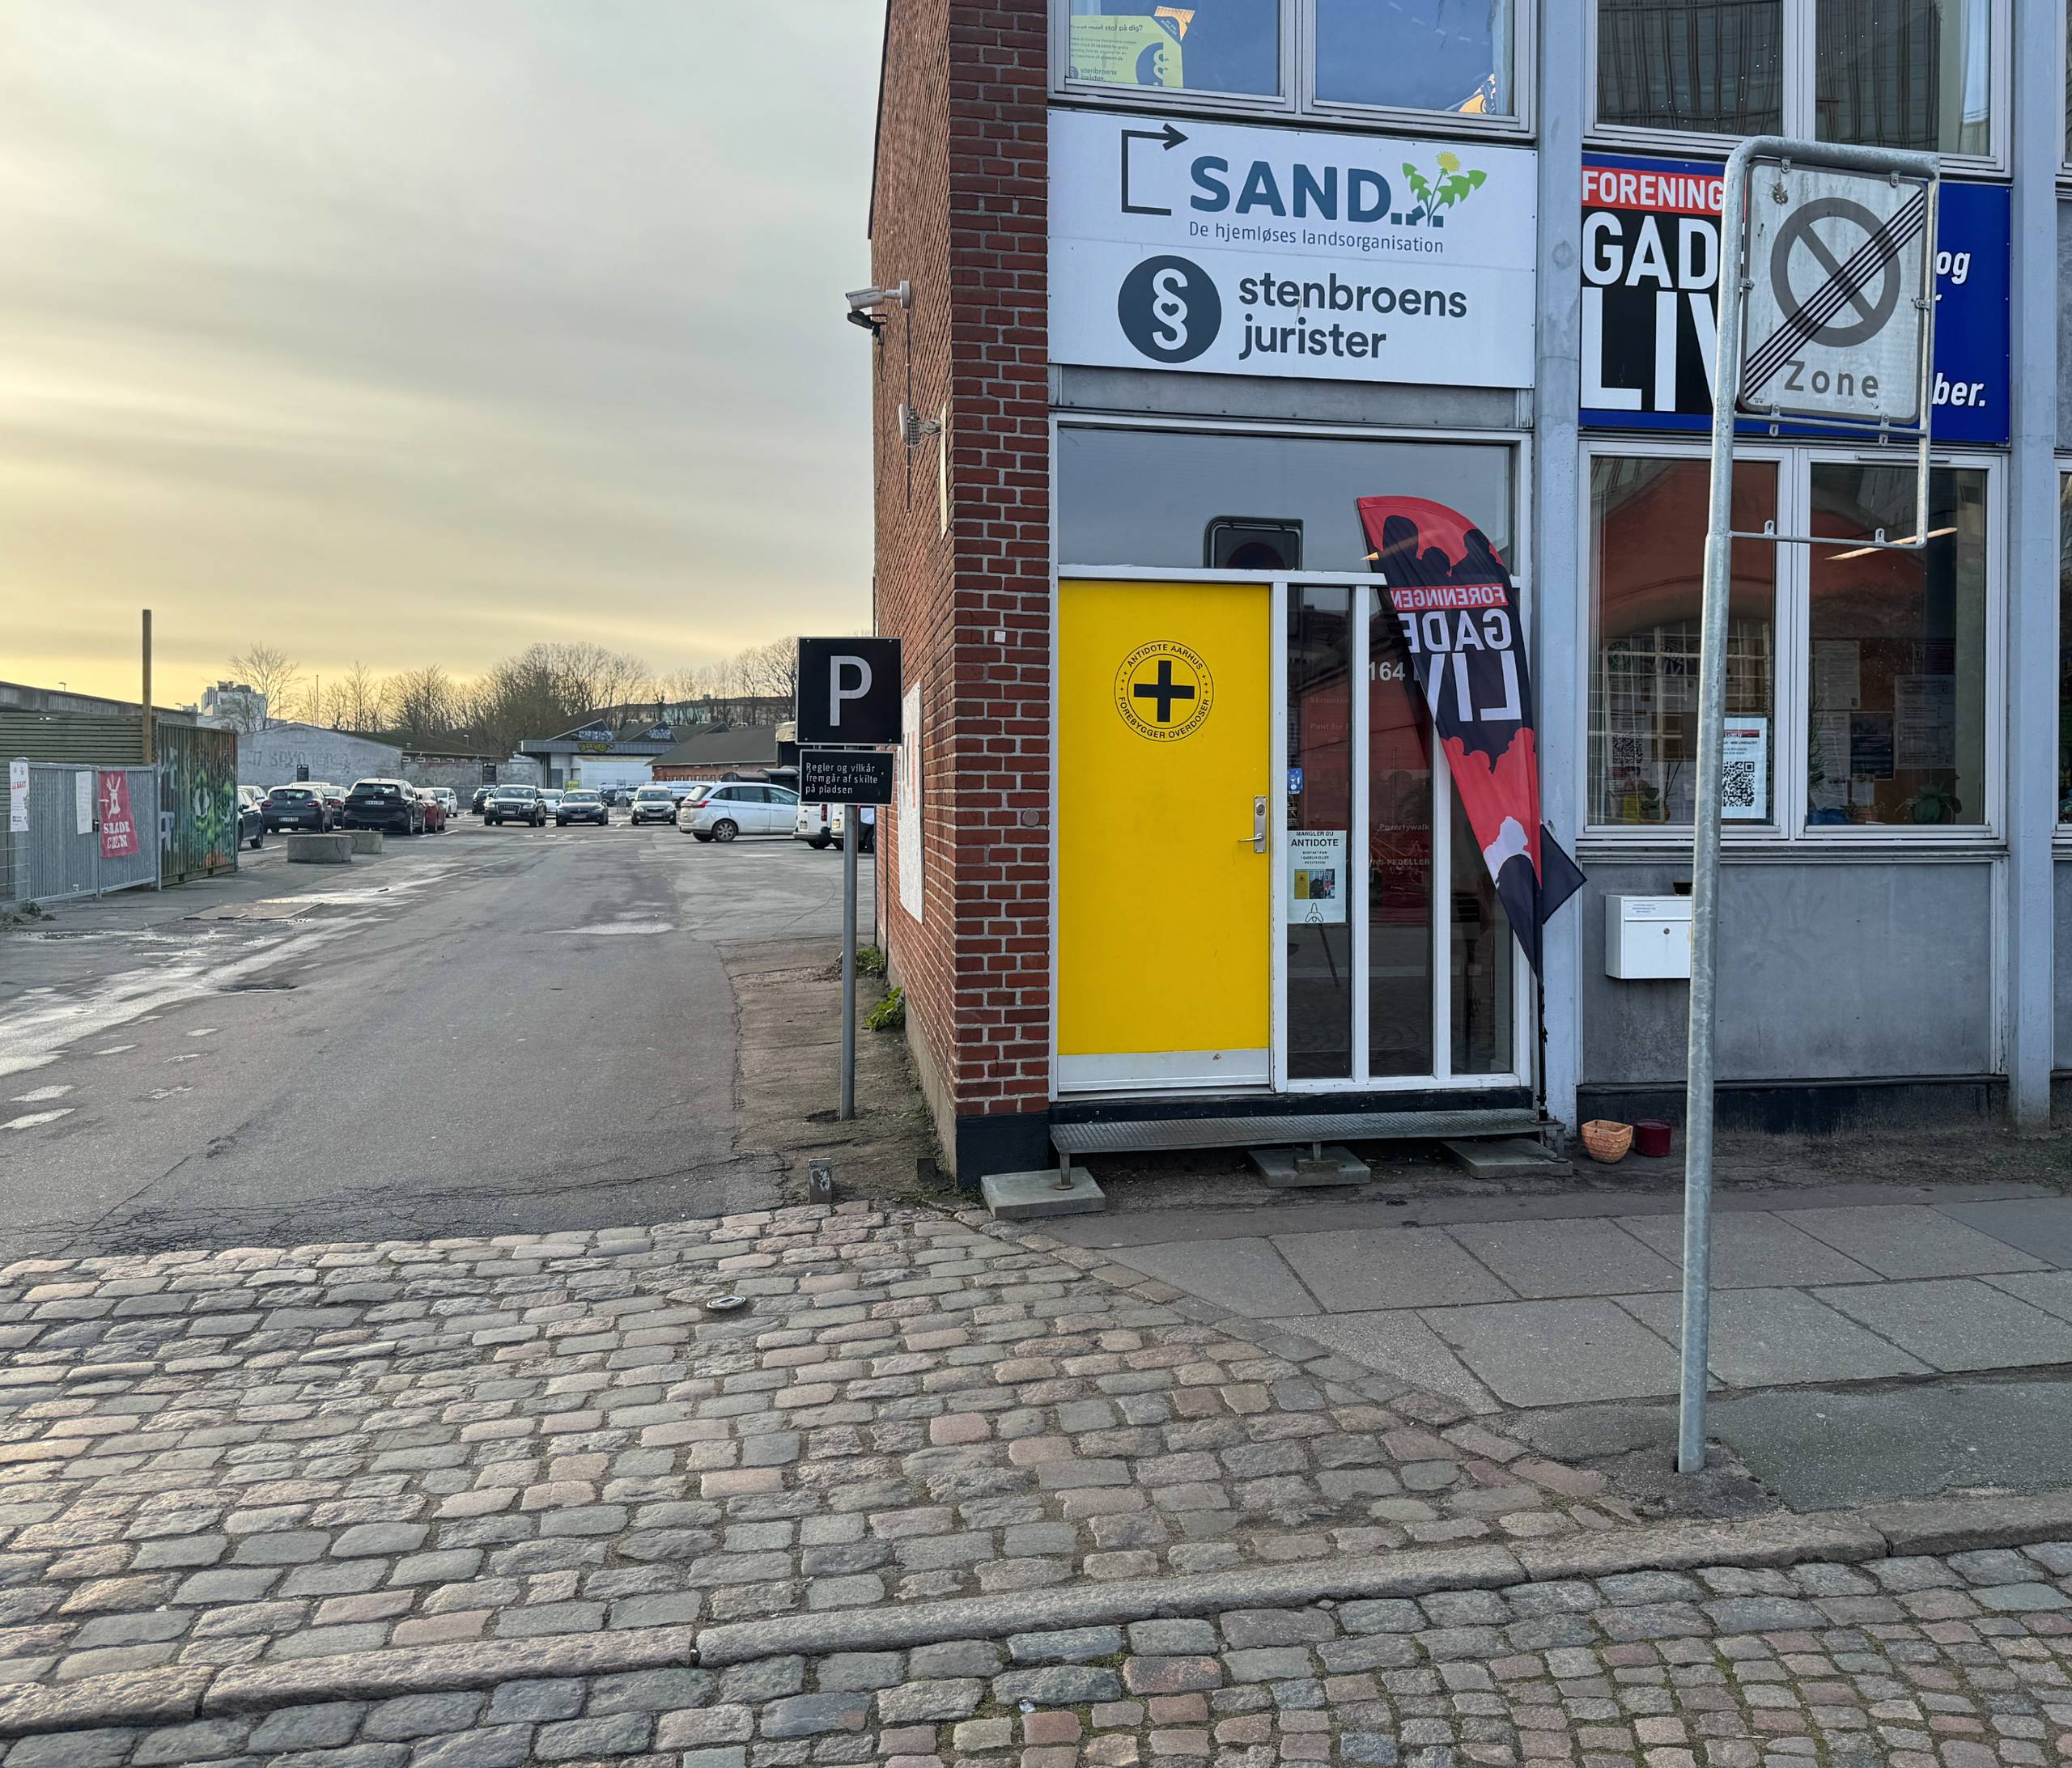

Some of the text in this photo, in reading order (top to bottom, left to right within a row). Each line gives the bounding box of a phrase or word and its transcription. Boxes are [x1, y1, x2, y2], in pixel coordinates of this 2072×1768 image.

[1189, 222, 1444, 253] De hjemløses landsorganisation
[1582, 211, 1719, 290] GAD
[1936, 251, 1970, 285] og
[1238, 272, 1467, 318] stenbroens
[1238, 314, 1386, 361] jurister
[1784, 360, 1879, 398] Zone
[1127, 644, 1203, 670] ANTIDOTE AARHUS
[1369, 661, 1405, 680] 164
[830, 655, 873, 726] P
[1119, 697, 1209, 738] FOREBYGGER OVERDOSER
[806, 762, 875, 774] Regler og vilkår
[806, 773, 878, 784] fremgår af skilte
[805, 784, 853, 795] på pladsen
[1291, 838, 1339, 847] ANTIDOTE
[1378, 823, 1430, 832] Povertywalk
